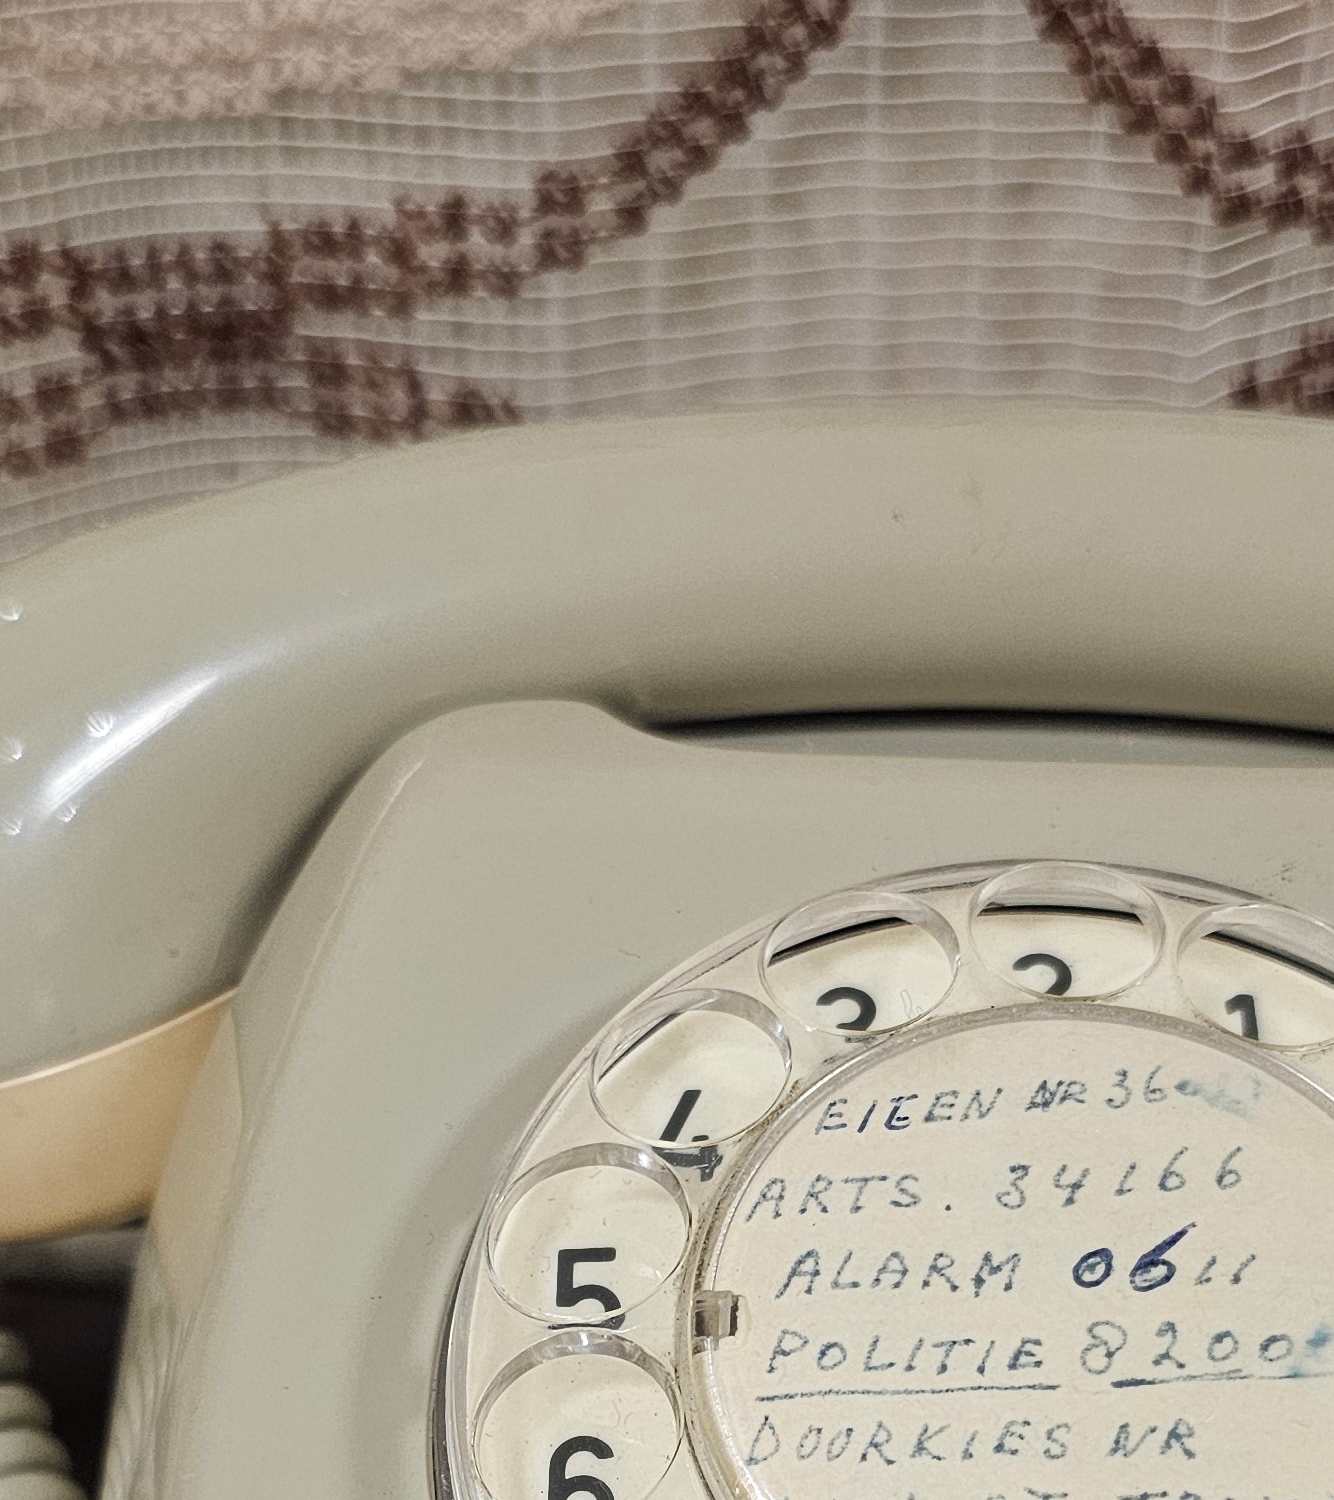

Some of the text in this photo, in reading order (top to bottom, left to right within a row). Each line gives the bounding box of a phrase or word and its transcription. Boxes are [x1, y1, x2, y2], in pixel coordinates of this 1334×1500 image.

[1224, 994, 1260, 1042] 1
[651, 1088, 724, 1183] 4
[995, 1145, 1245, 1209] 34166
[547, 1247, 627, 1331] 5
[774, 1248, 1023, 1298] ALARM
[765, 1319, 1334, 1376] POLITIE 8200
[744, 1415, 1199, 1467] DOORKIES NR
